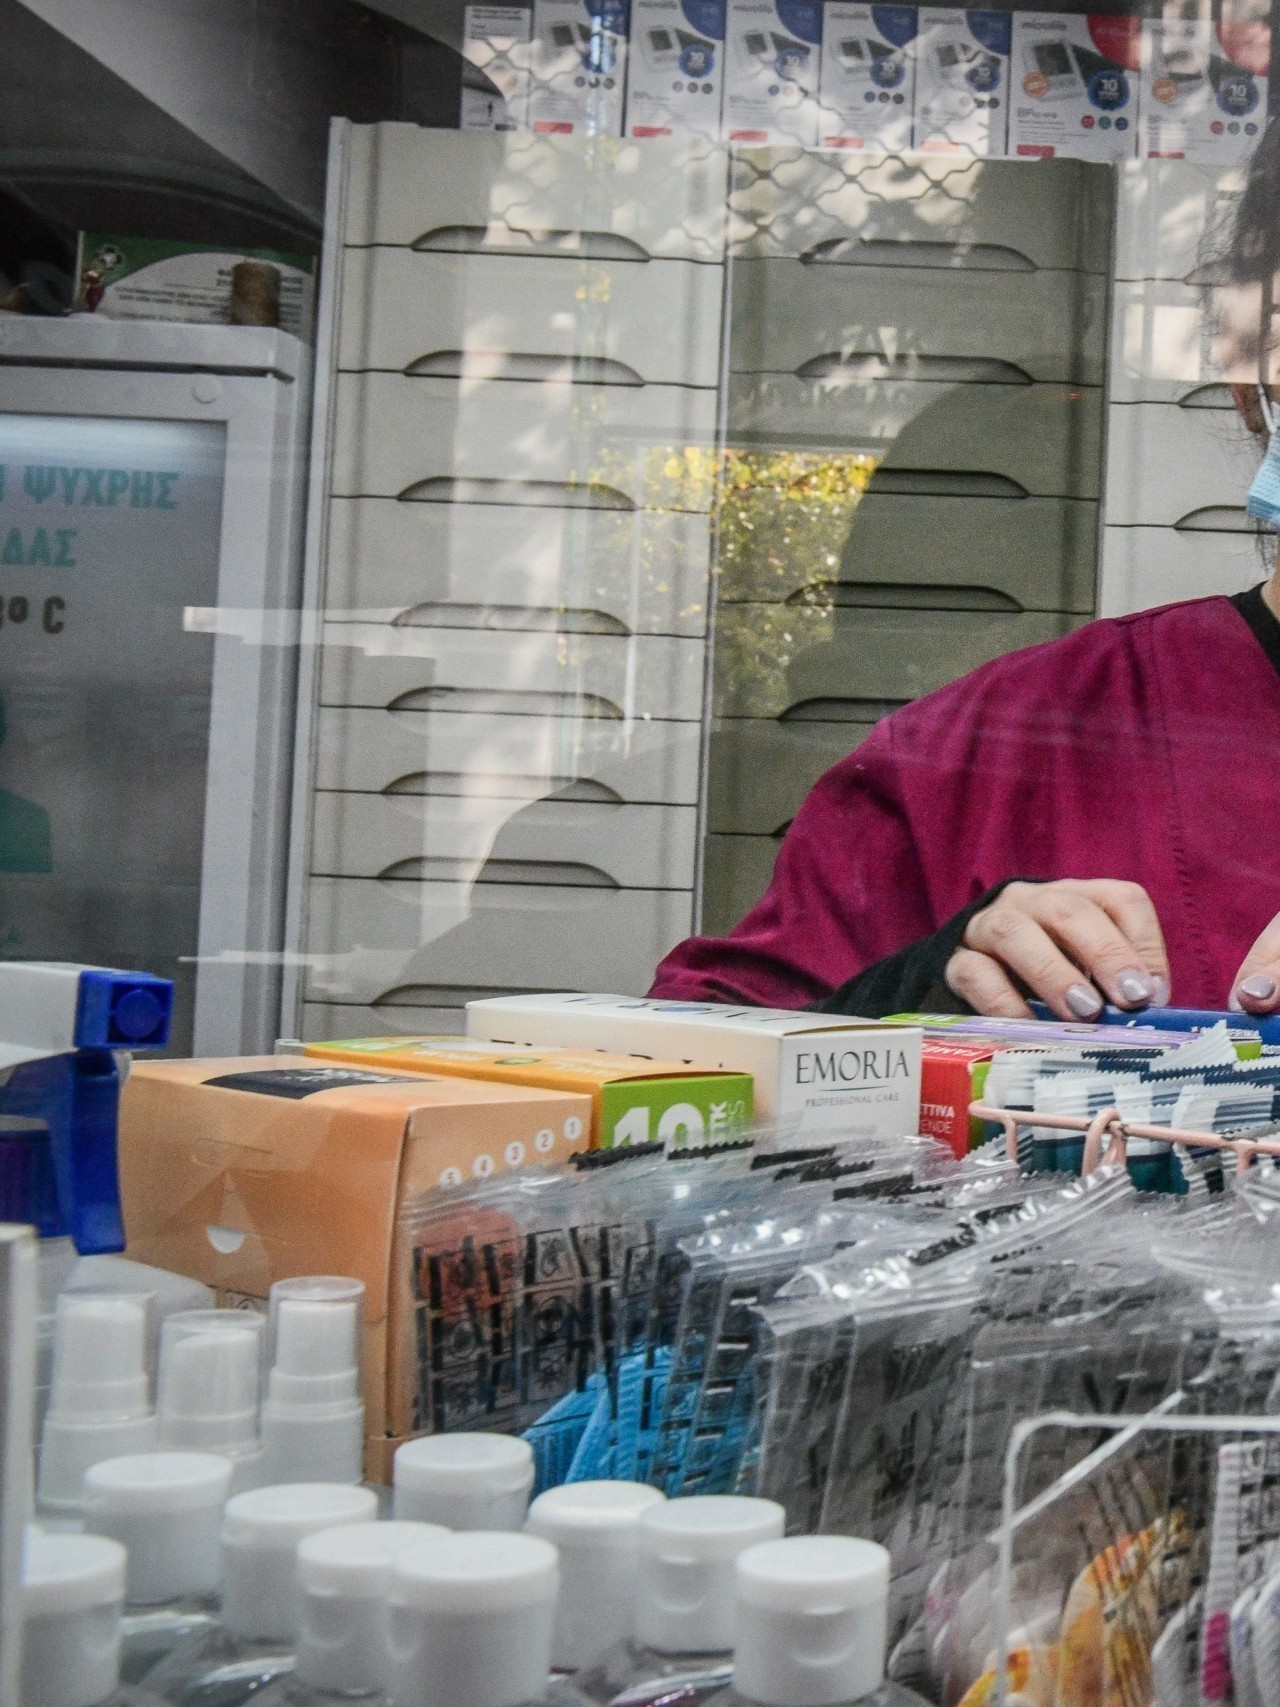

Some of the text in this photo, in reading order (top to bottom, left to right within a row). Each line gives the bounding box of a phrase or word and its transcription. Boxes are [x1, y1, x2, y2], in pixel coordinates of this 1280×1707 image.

[1102, 79, 1117, 91] 10
[1230, 85, 1247, 97] 10
[24, 465, 179, 510] ΨΥΧΡΗΣ
[796, 1049, 909, 1085] EMORIA
[876, 1093, 899, 1102] CARE
[614, 1103, 704, 1156] 10
[920, 1120, 953, 1133] ENDE
